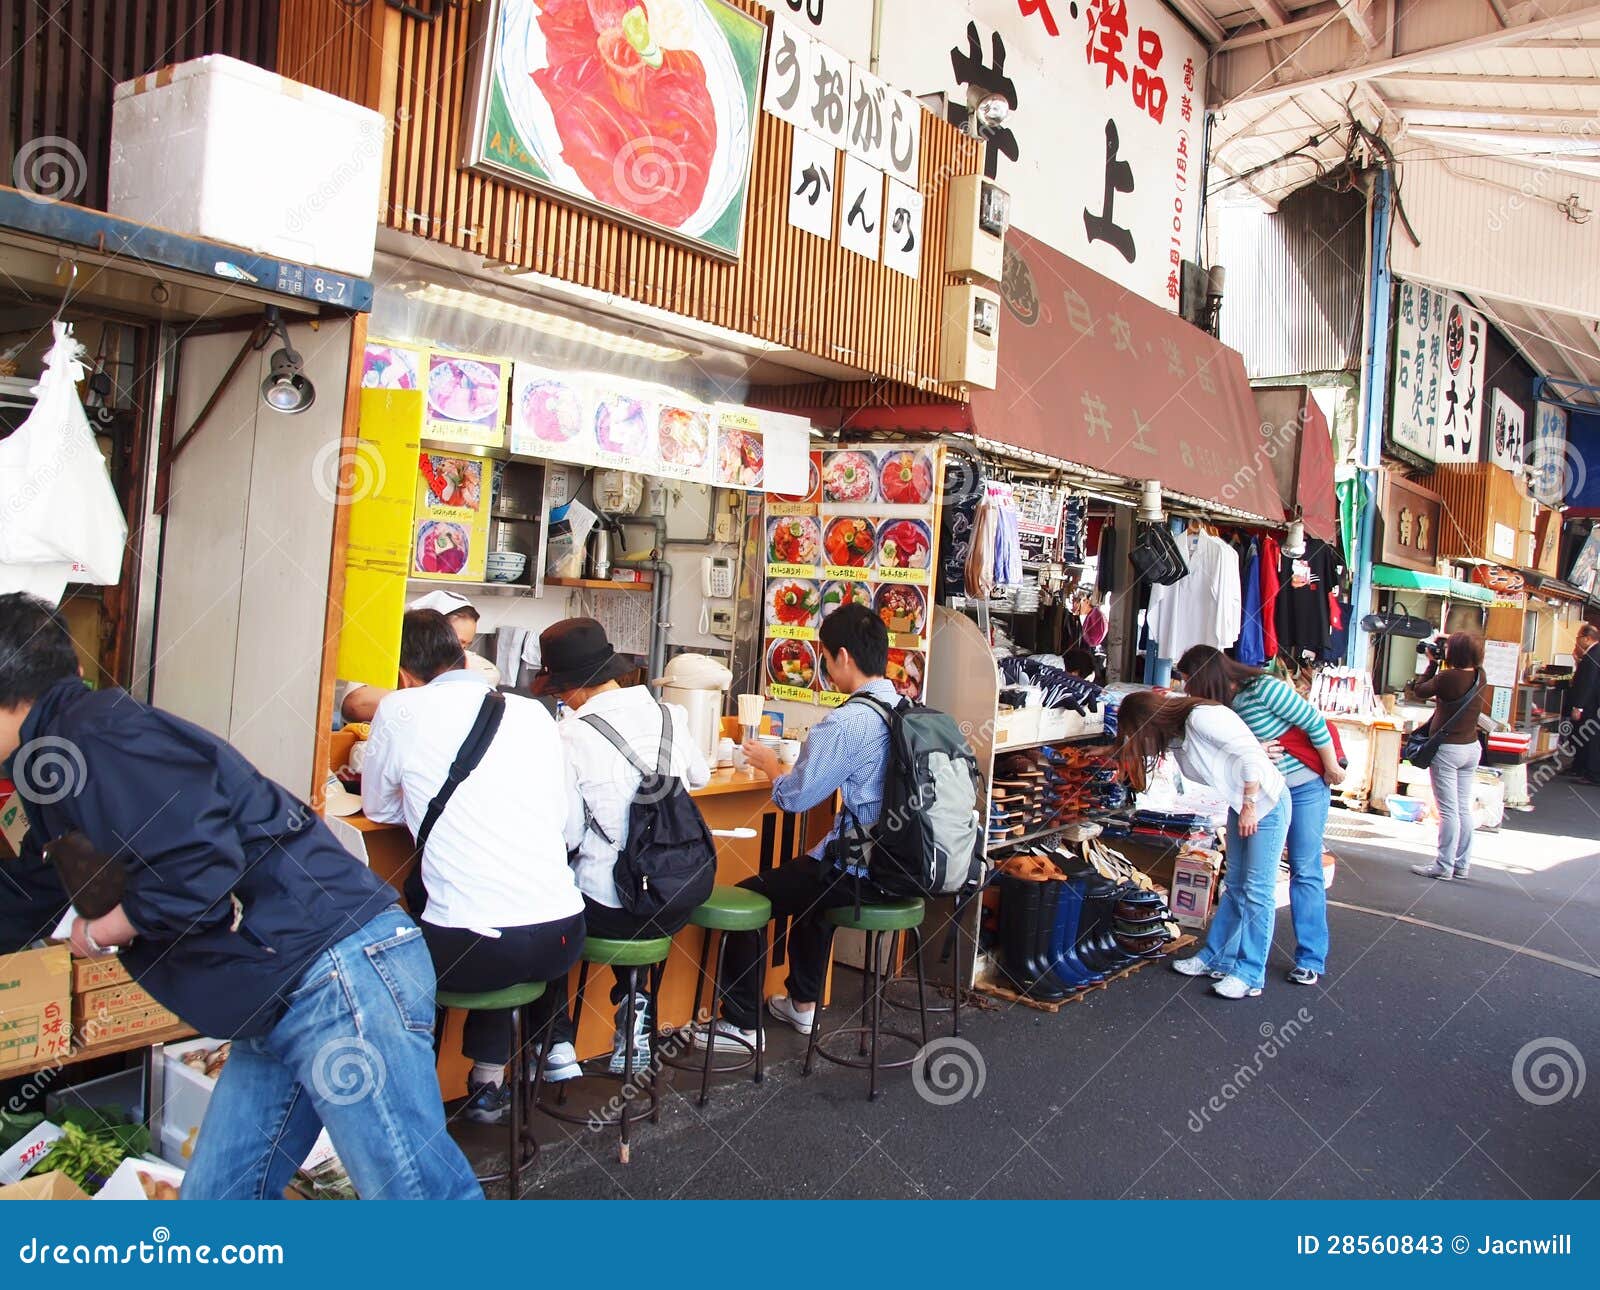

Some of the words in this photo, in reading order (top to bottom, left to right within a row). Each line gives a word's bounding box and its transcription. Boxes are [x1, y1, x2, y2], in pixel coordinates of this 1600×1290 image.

[775, 30, 914, 173] うおがし
[949, 20, 1136, 264] 井上
[794, 161, 915, 253] かんの
[314, 278, 346, 299] 8-7
[1081, 390, 1158, 456] 井上
[1461, 318, 1480, 455] ラーメン
